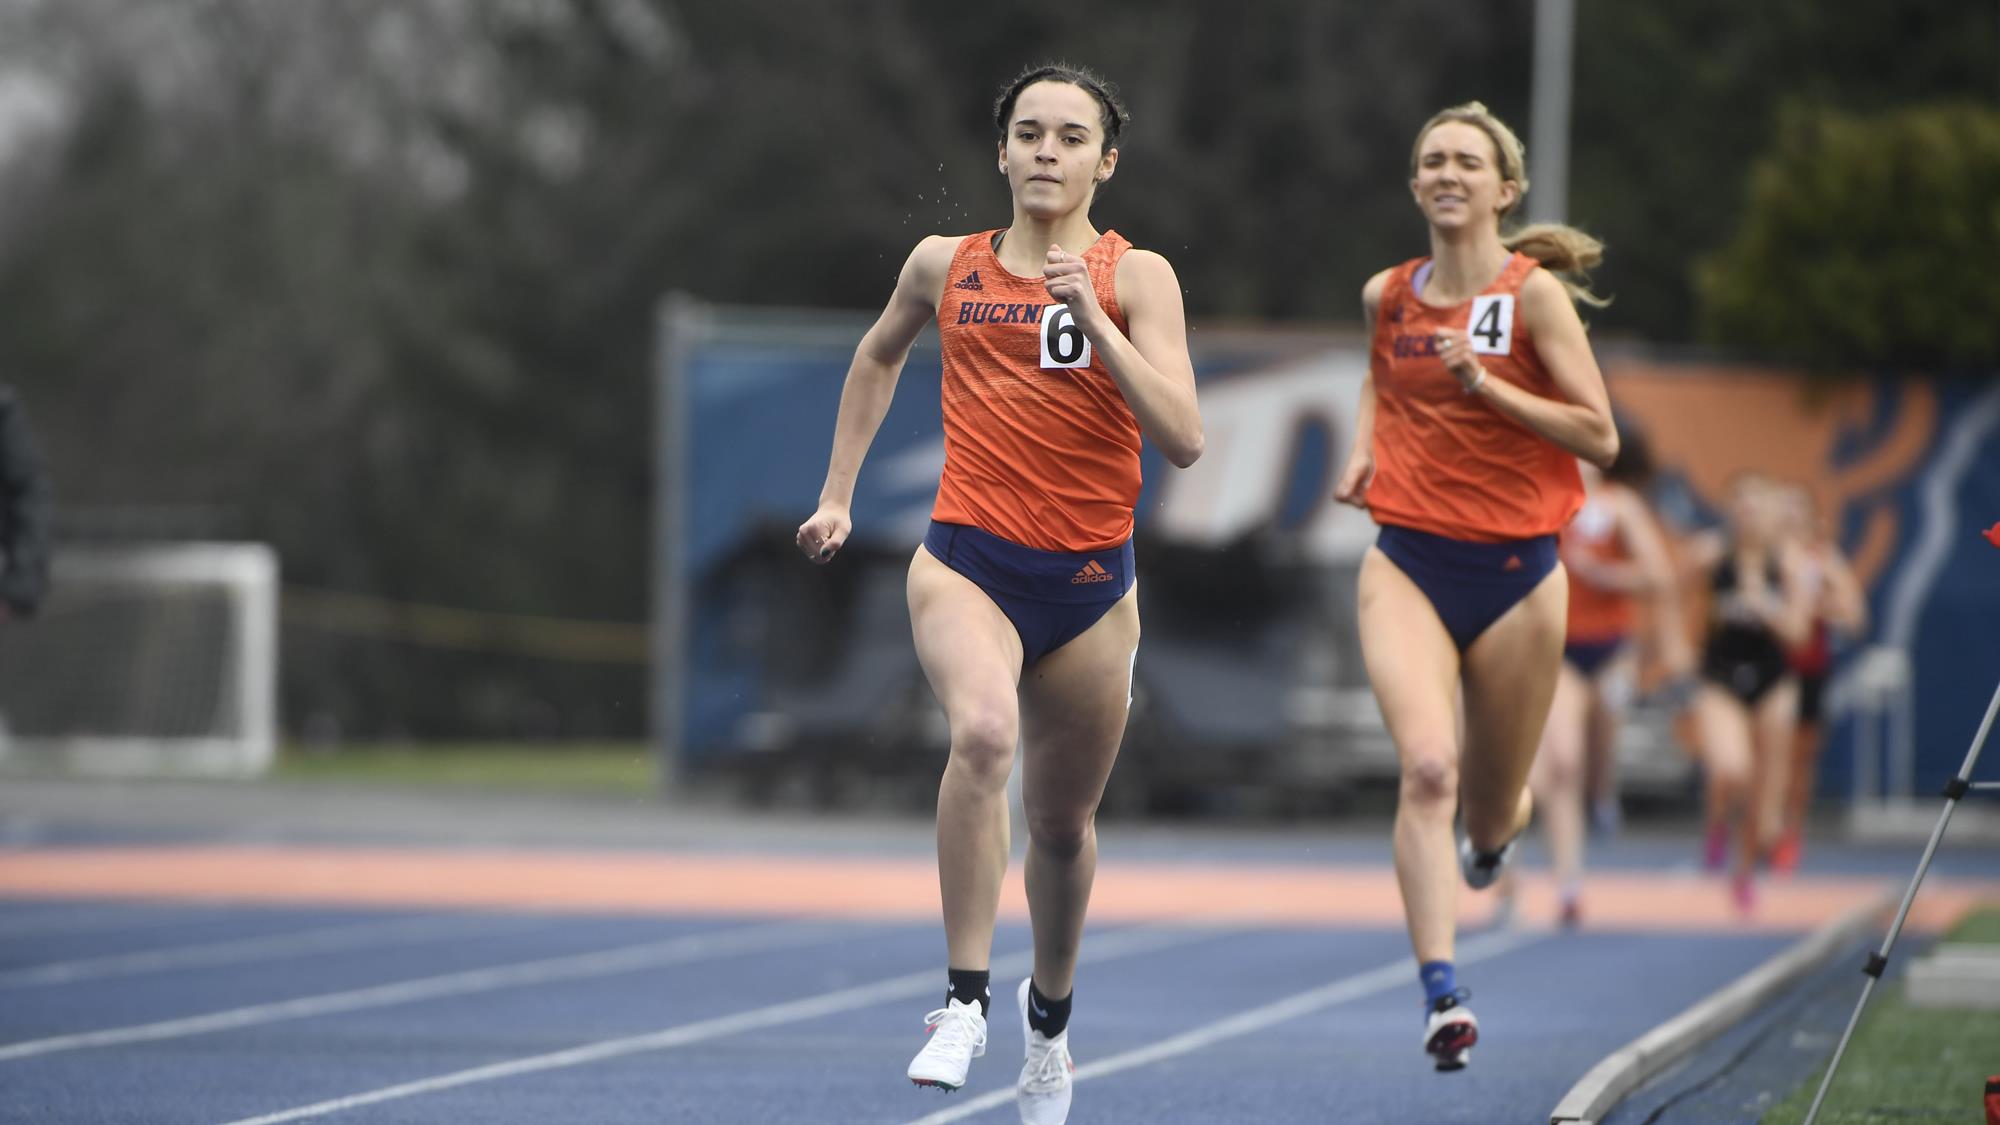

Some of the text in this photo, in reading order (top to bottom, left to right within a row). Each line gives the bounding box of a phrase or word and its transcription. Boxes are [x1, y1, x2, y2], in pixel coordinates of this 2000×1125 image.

[957, 302, 1050, 324] BUCKN
[1472, 299, 1503, 348] 4
[1046, 307, 1084, 364] 6
[1071, 573, 1114, 584] adidas
